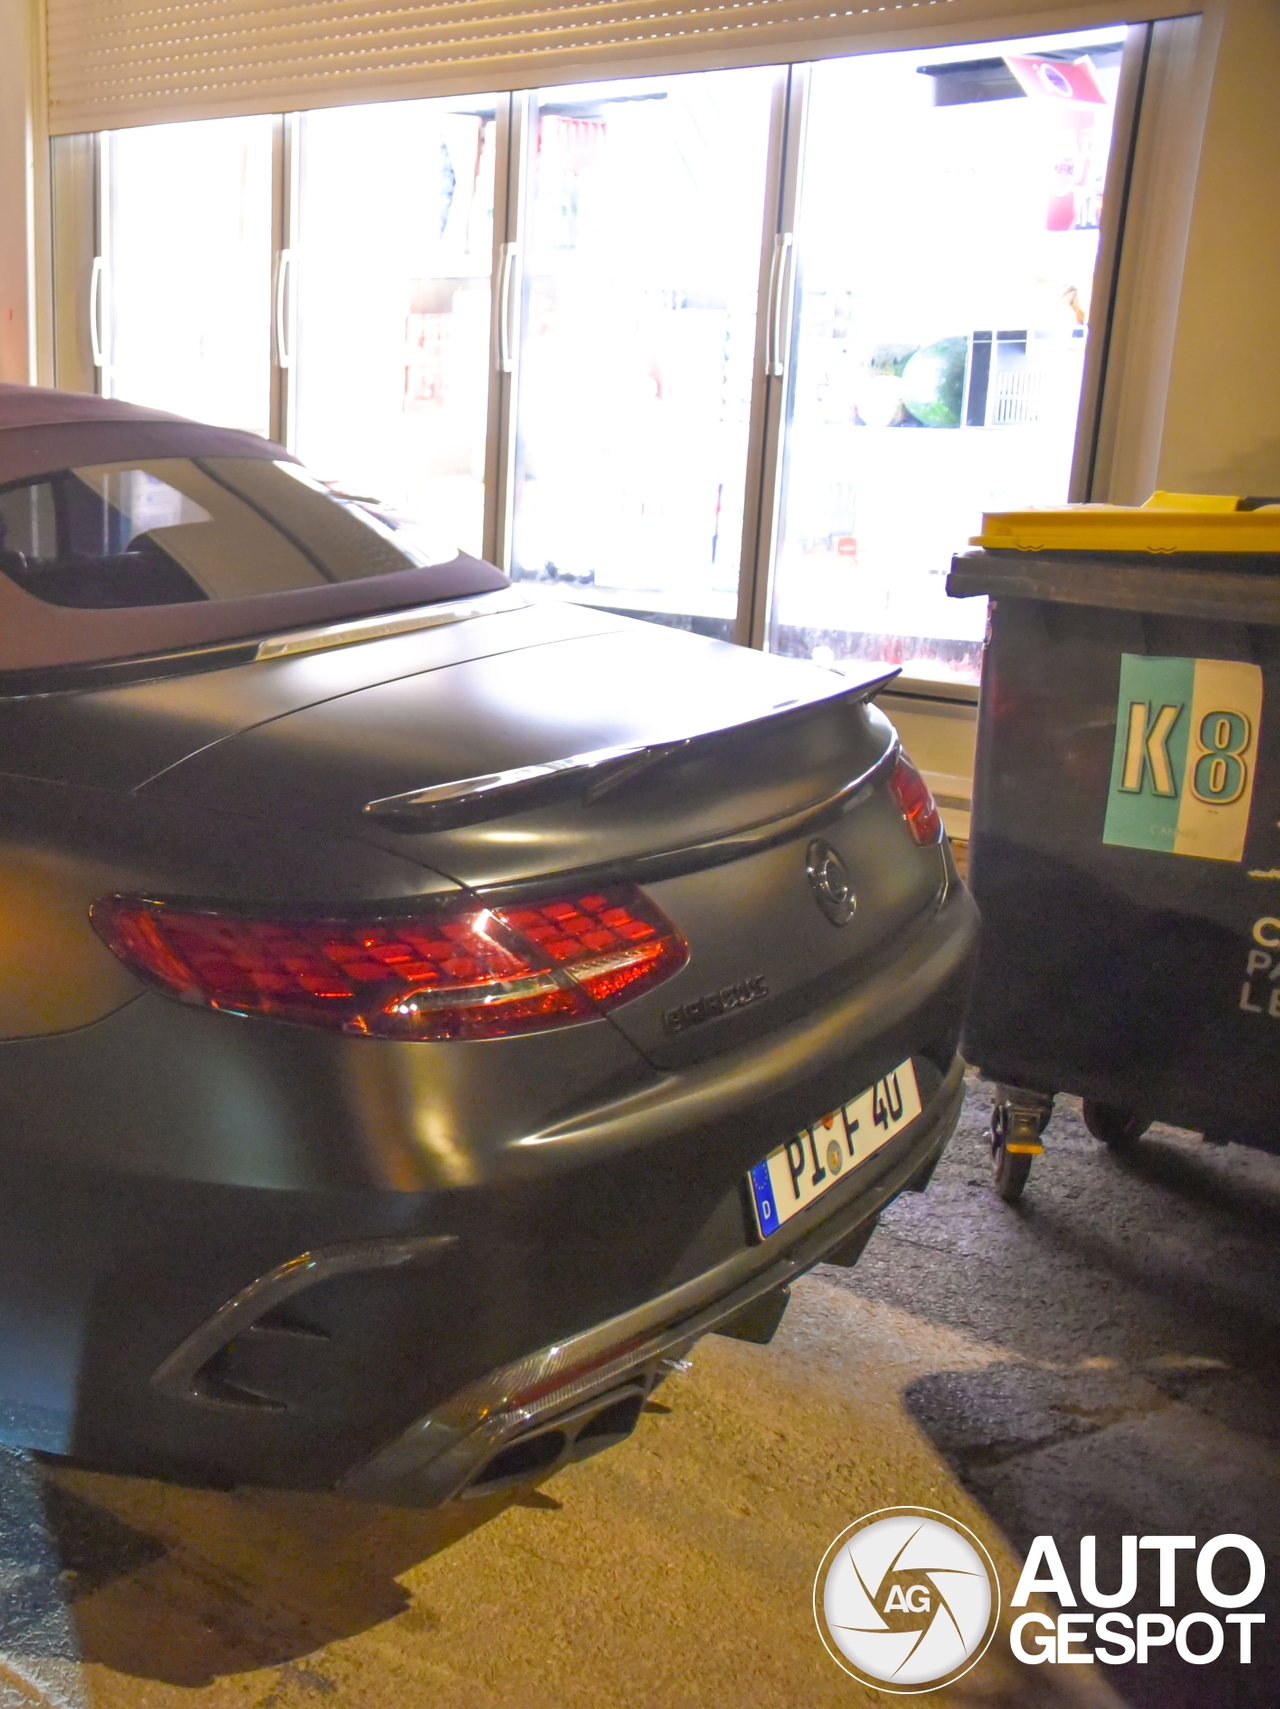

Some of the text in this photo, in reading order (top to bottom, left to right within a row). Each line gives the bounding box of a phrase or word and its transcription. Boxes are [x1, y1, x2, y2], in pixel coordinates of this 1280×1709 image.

[1118, 700, 1251, 804] K8
[783, 1126, 826, 1200] PI
[762, 1199, 772, 1220] D
